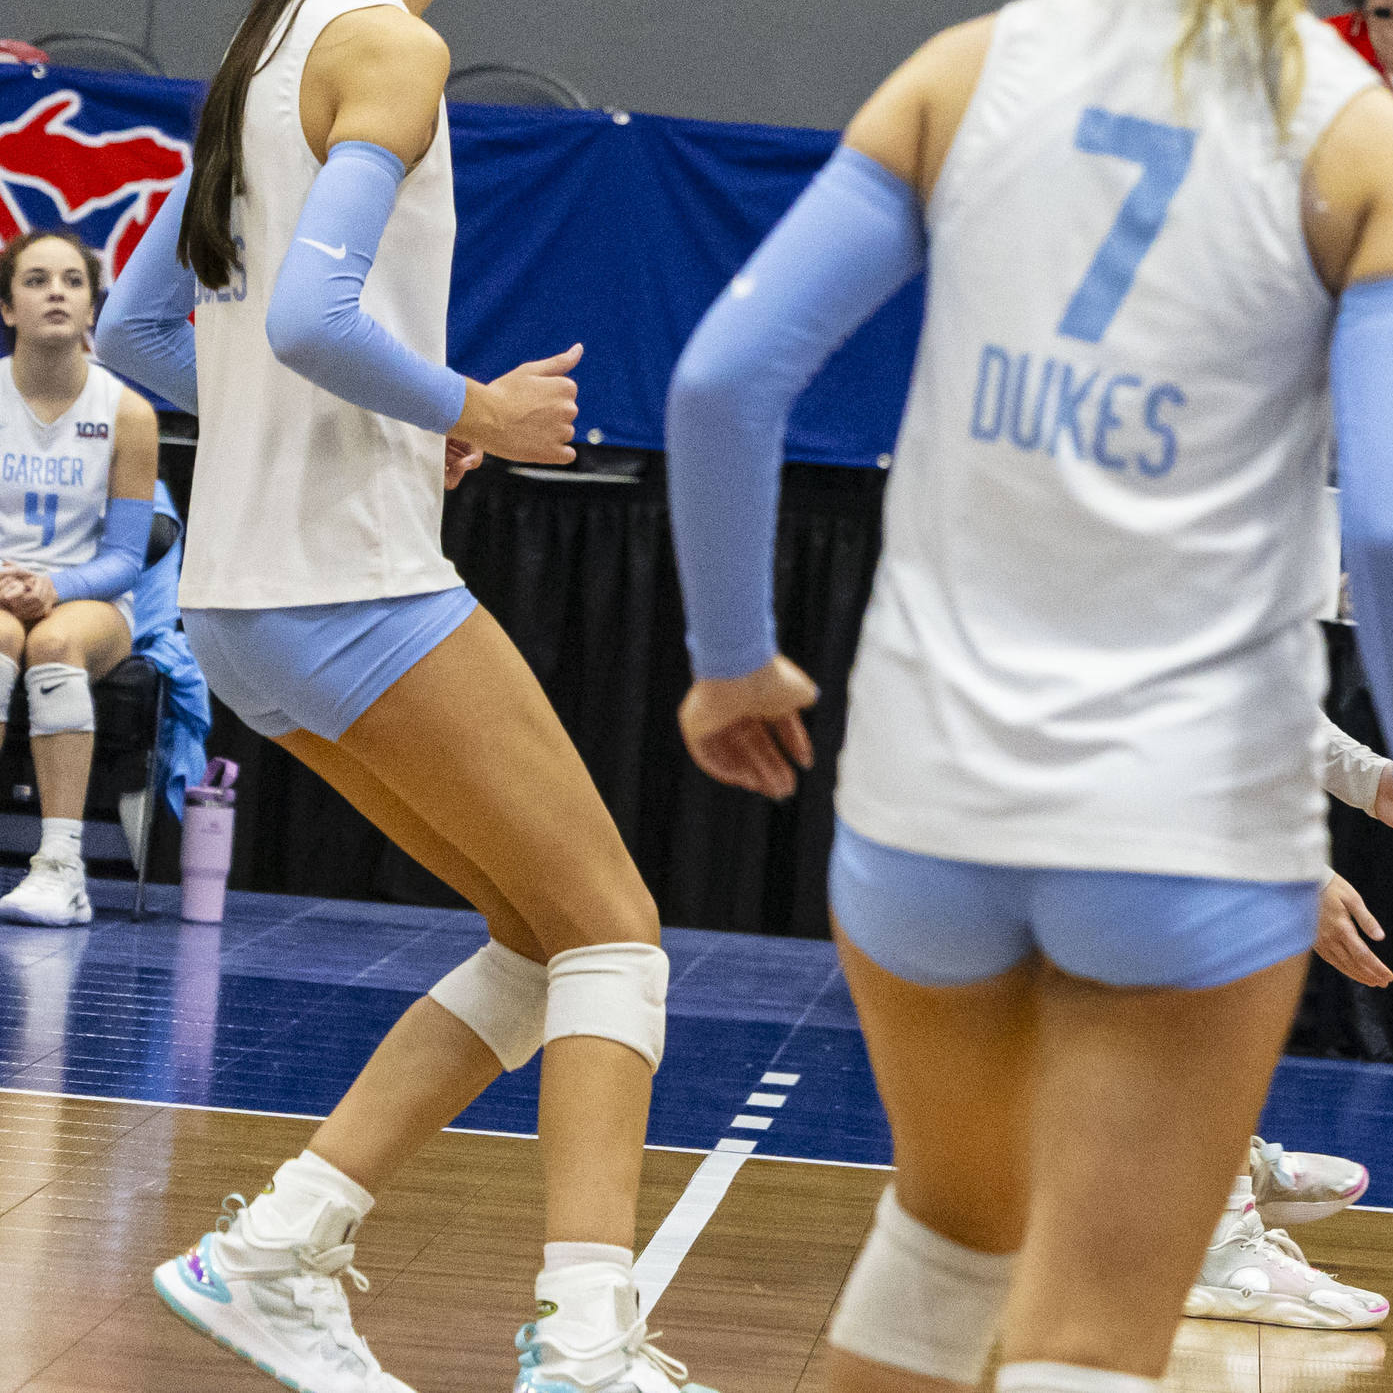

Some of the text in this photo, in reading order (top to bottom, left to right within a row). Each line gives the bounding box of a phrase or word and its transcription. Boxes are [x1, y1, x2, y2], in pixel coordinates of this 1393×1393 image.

[1056, 106, 1197, 344] 7
[969, 343, 1187, 480] DUKES
[2, 452, 84, 486] GARBER
[24, 491, 59, 547] 4
